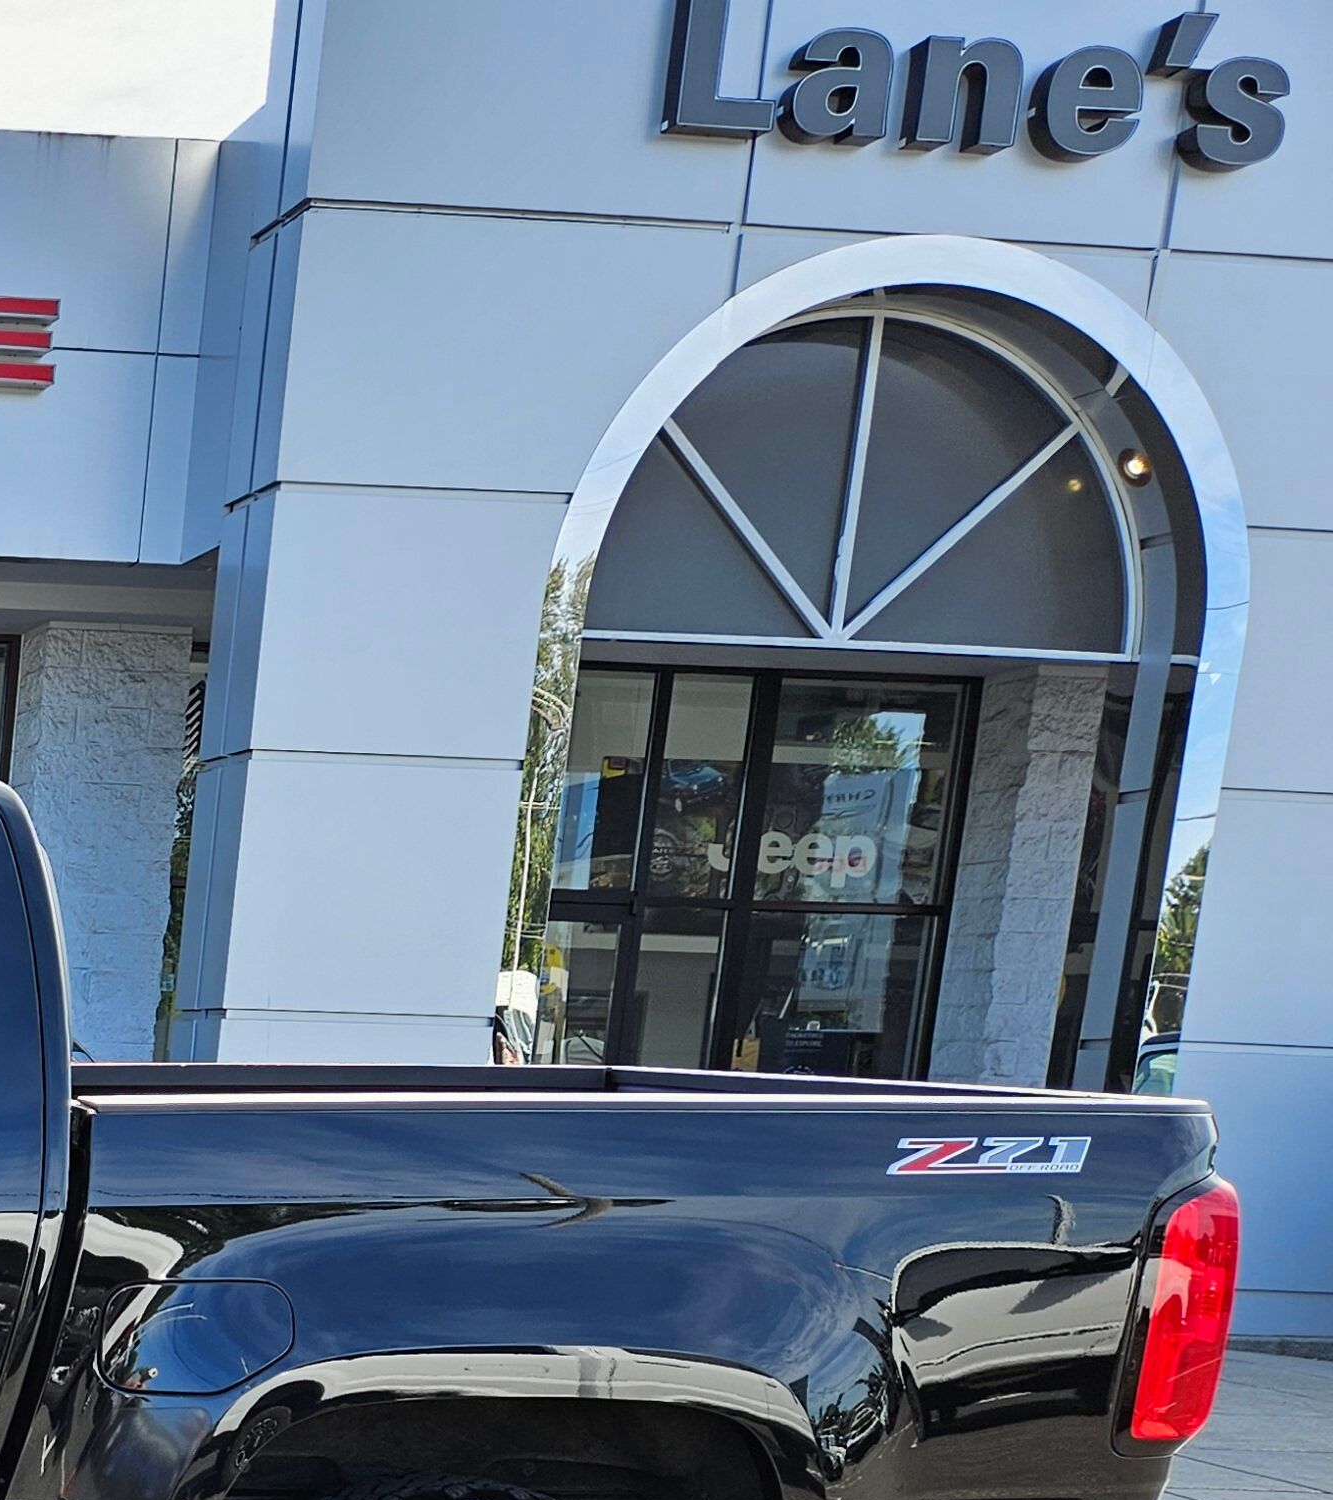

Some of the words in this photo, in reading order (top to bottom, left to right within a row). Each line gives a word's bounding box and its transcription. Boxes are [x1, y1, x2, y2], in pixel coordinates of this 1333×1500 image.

[660, 0, 1291, 173] Lane's
[886, 1136, 1091, 1175] Z71
[1008, 1163, 1036, 1172] OFF
[1040, 1163, 1079, 1171] ROAD
